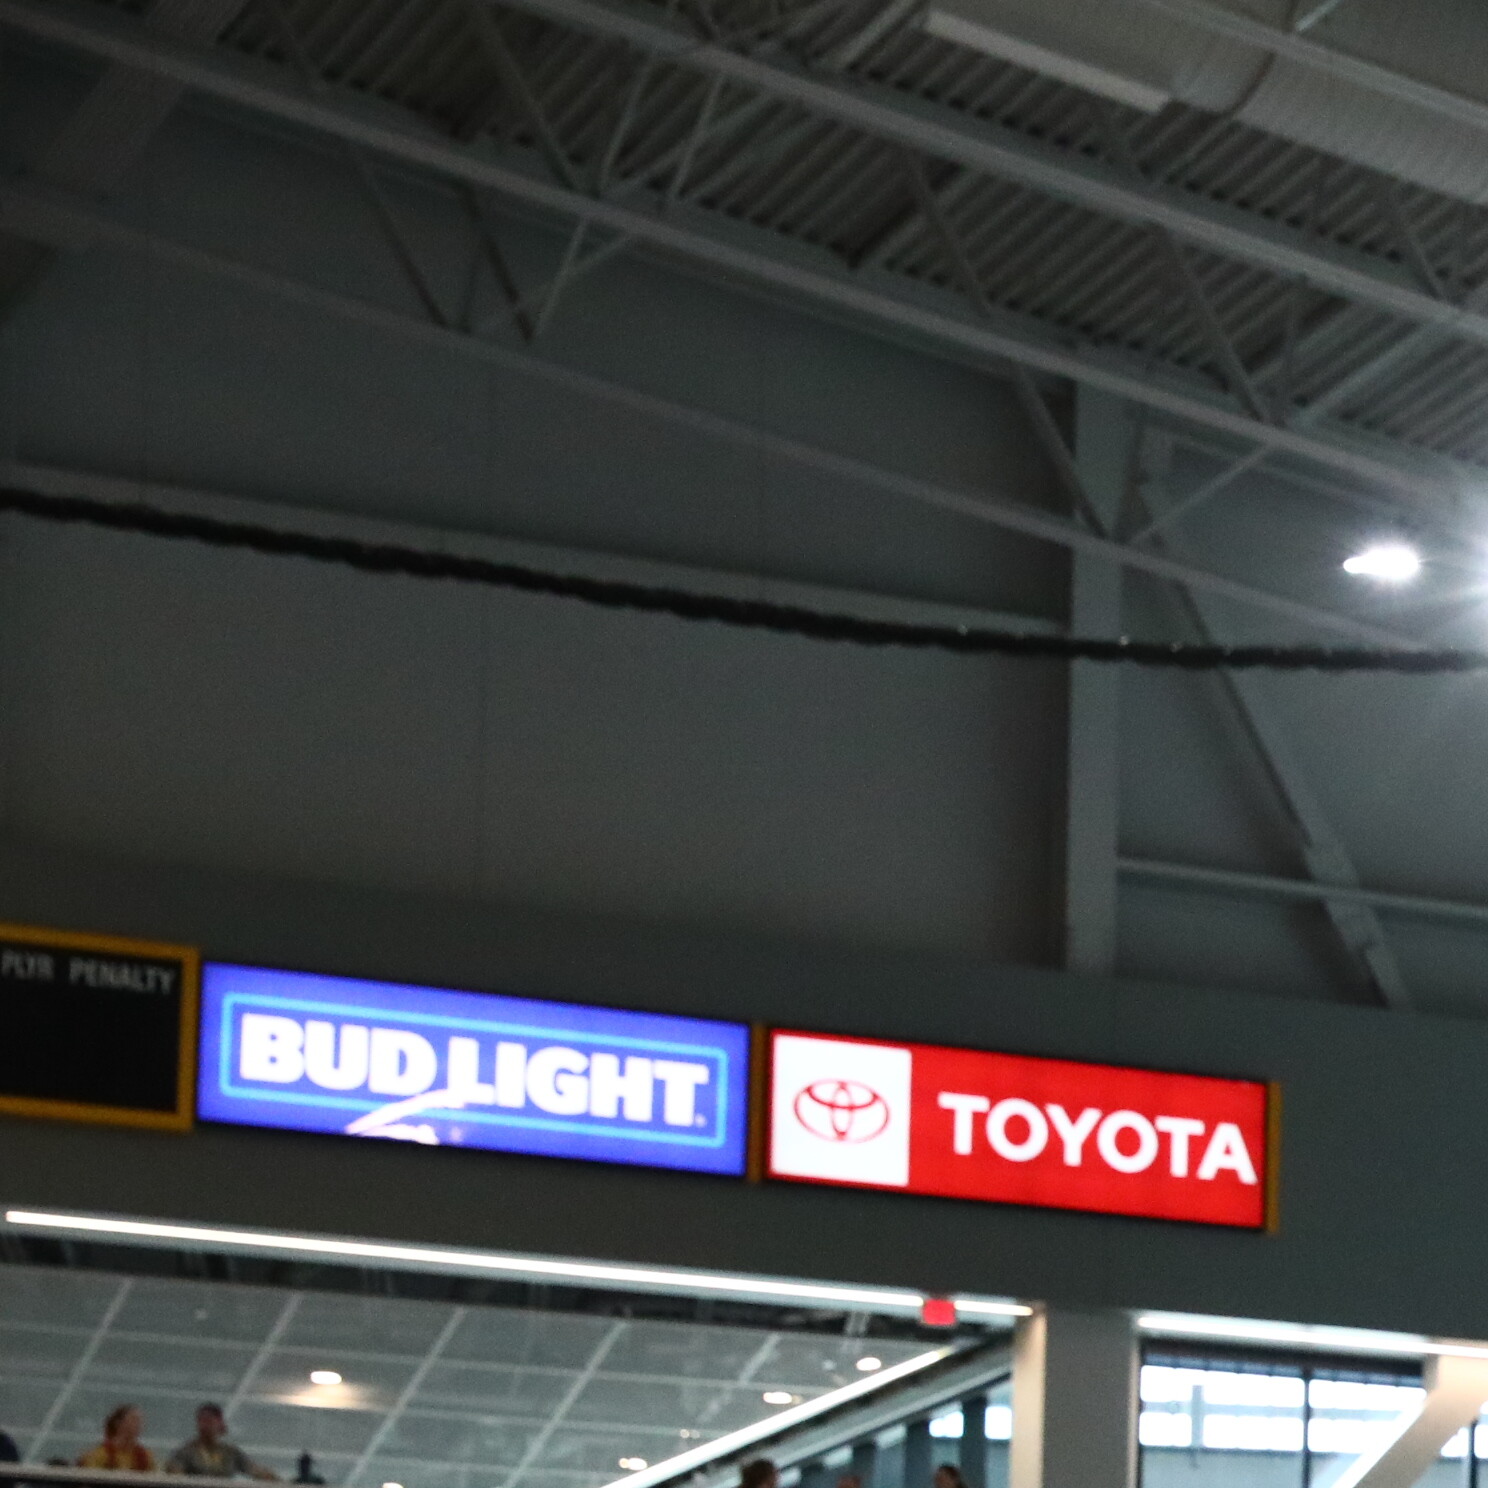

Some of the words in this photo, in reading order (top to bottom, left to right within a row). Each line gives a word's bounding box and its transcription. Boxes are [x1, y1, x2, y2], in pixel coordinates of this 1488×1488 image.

[239, 1011, 437, 1096] BUD
[447, 1036, 709, 1127] LIGHT
[938, 1090, 1258, 1187] TOYOTA
